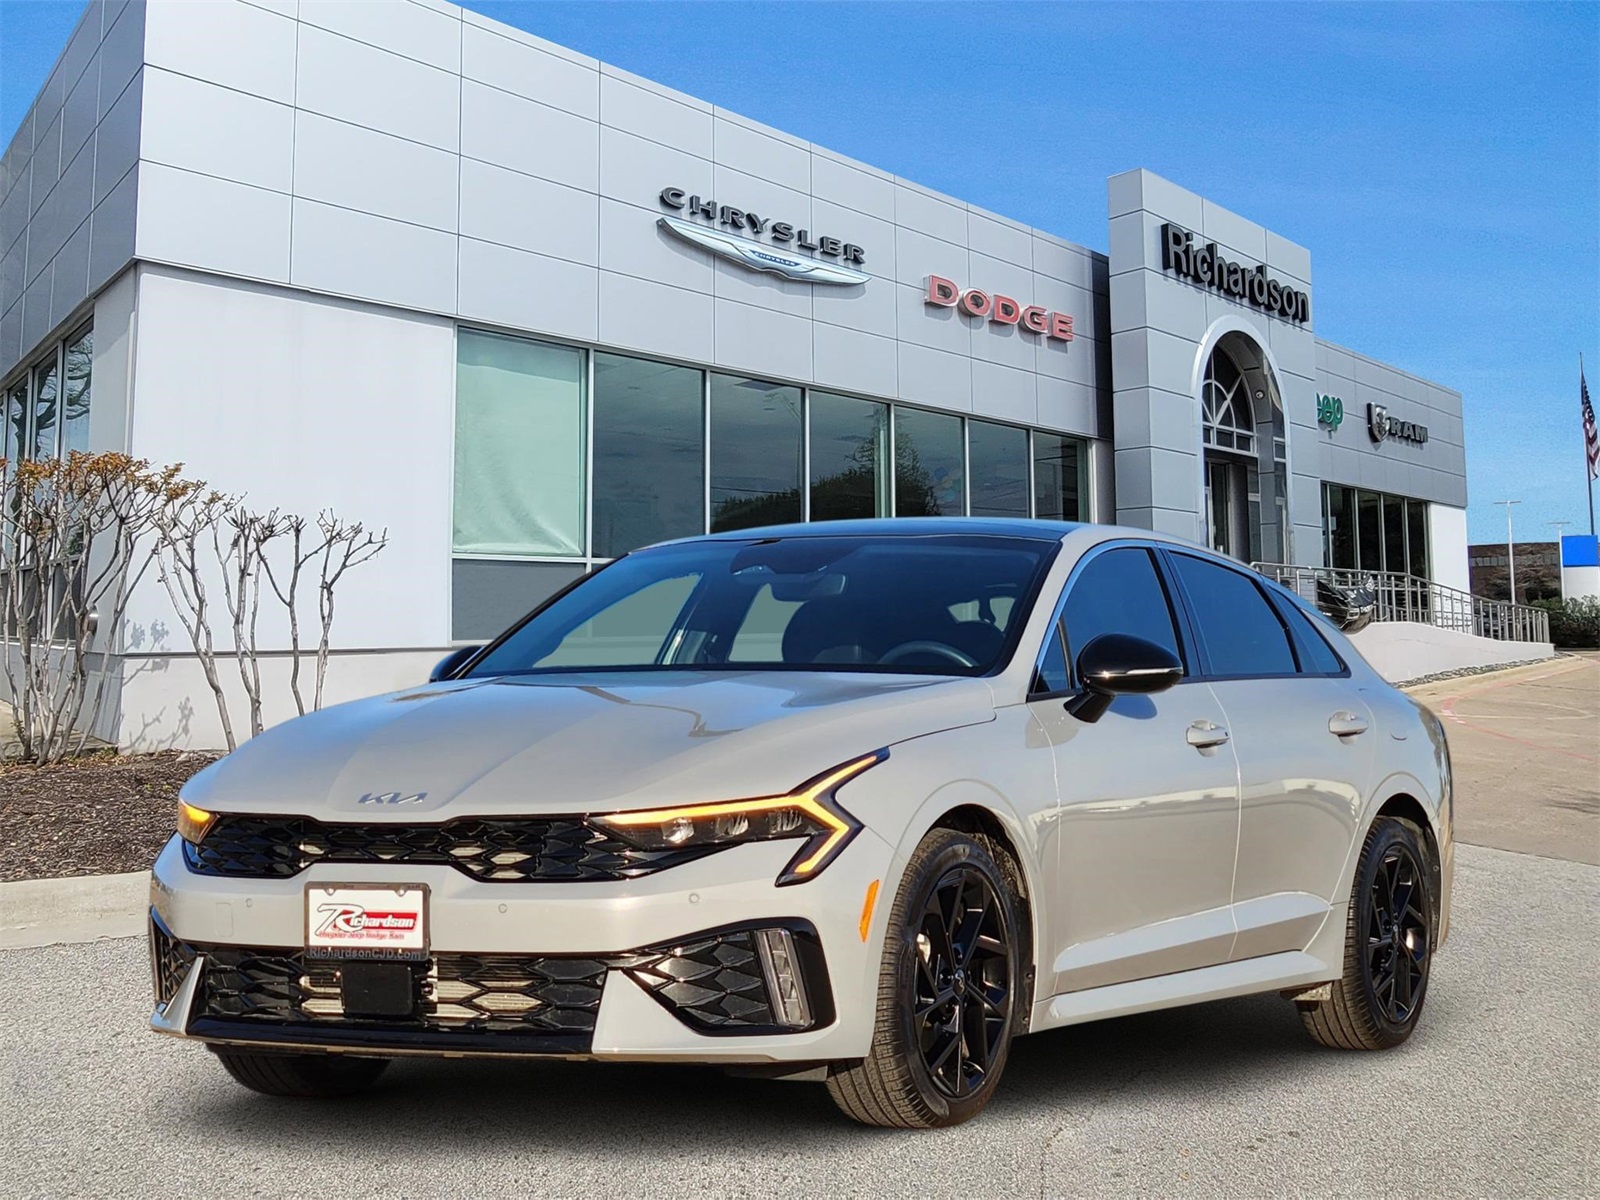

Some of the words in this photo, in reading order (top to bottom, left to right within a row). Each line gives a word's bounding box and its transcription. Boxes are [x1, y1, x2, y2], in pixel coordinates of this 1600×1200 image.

[659, 186, 866, 265] CHRYSLER
[1160, 222, 1310, 323] Richardson
[924, 274, 1075, 343] DODGE
[1387, 416, 1429, 444] RAM
[358, 792, 428, 804] KIA
[315, 902, 417, 937] Richardson
[309, 947, 421, 960] RichardsonCJD.com
